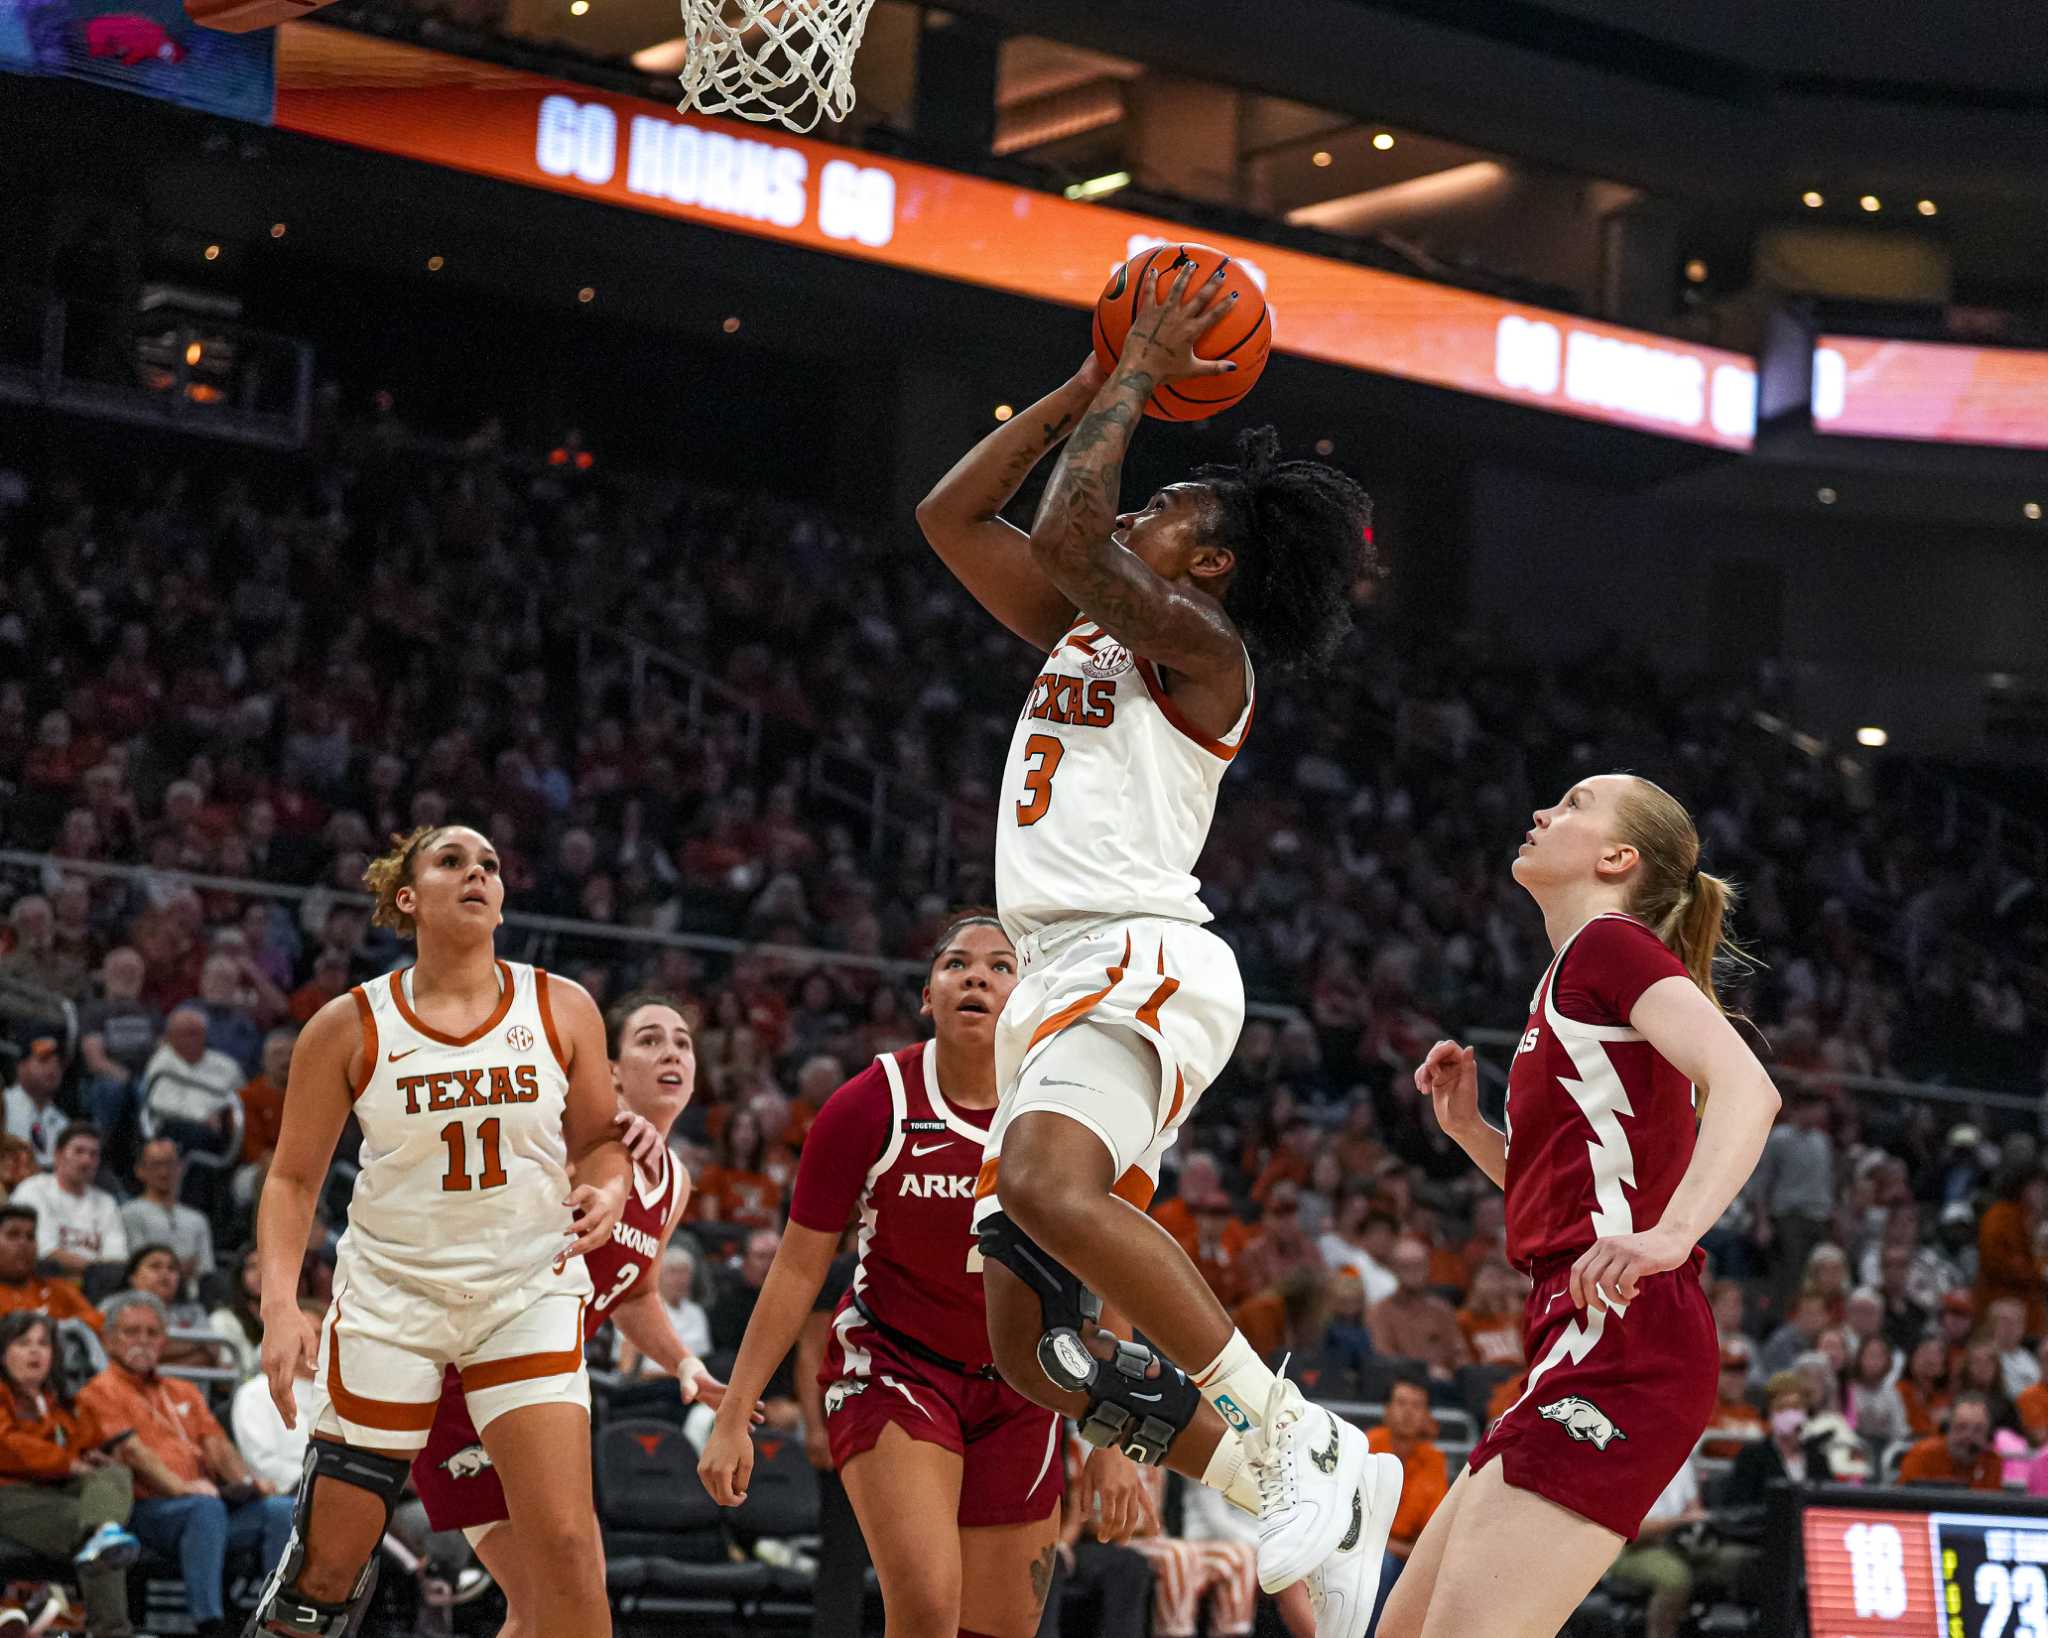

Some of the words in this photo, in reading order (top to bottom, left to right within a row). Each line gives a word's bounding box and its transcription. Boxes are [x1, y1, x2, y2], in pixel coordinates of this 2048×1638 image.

[537, 95, 616, 184] GO
[627, 114, 807, 228] HORNS
[1093, 645, 1127, 670] SEC
[1016, 734, 1064, 827] 3
[507, 1026, 533, 1051] SEC
[397, 1065, 538, 1114] TEXAS
[441, 1118, 507, 1191] 11
[898, 1173, 978, 1199] ARK
[612, 1221, 659, 1259] RKANS
[594, 1262, 640, 1312] 3
